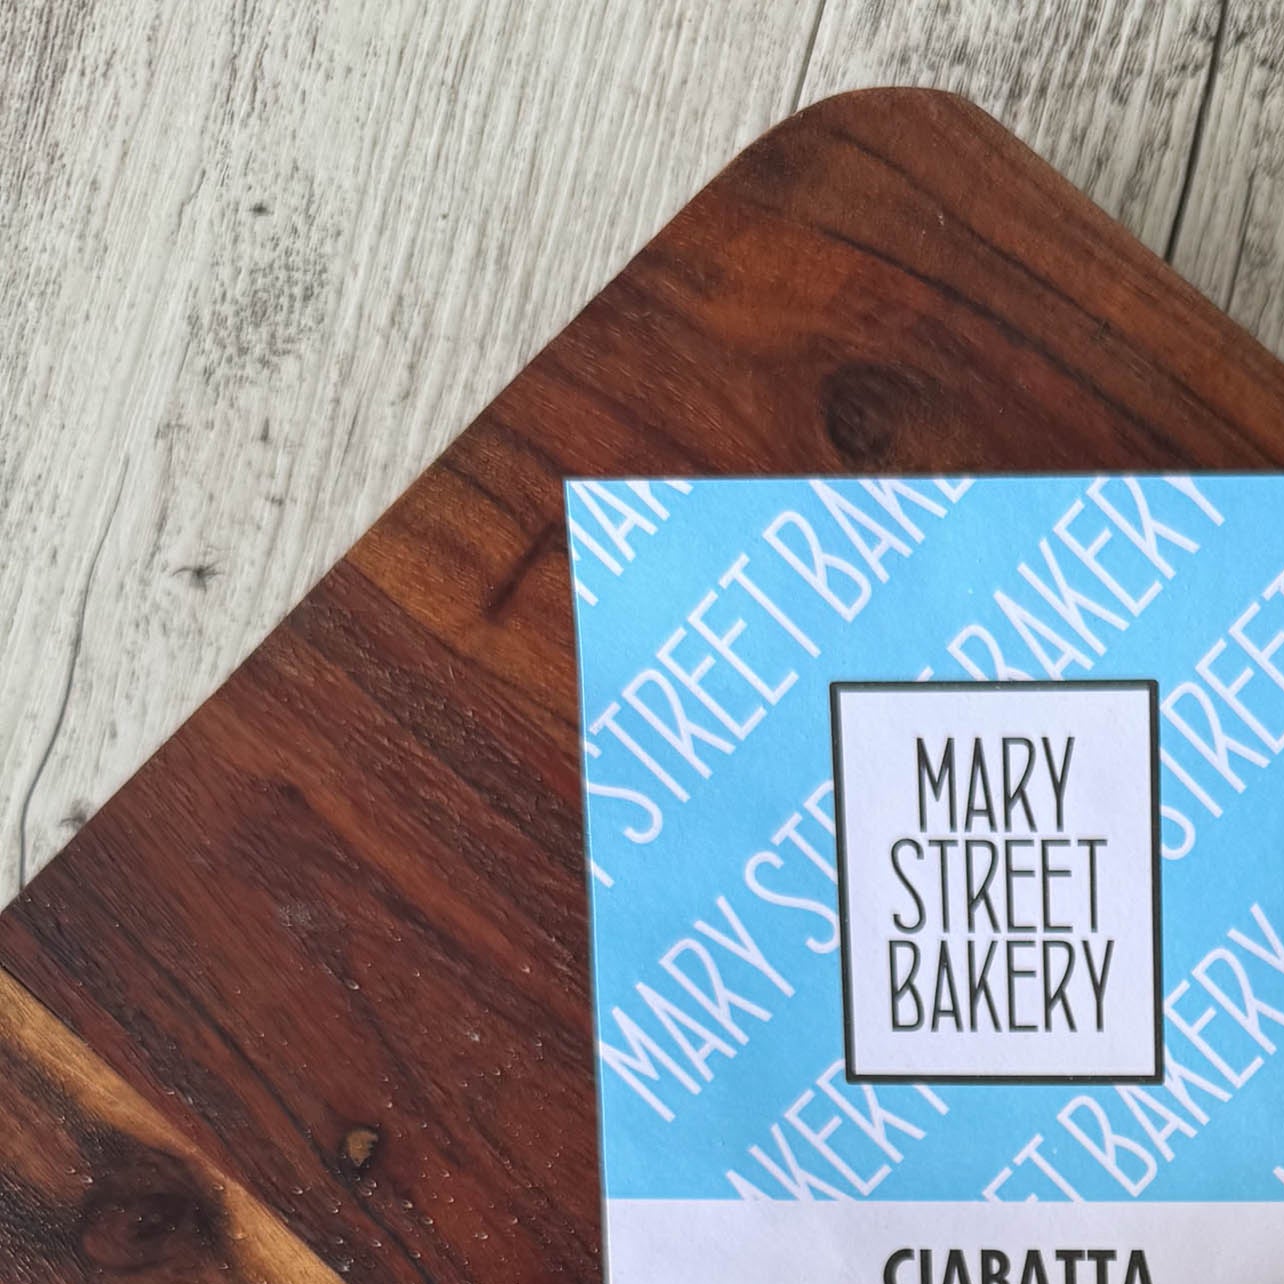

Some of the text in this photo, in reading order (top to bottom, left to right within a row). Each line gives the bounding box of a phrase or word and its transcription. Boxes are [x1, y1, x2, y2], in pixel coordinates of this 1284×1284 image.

[585, 478, 976, 844] STREET BAK
[915, 735, 1076, 833] MARY
[890, 838, 1109, 934] STREET
[598, 895, 795, 1123] MARY
[888, 940, 1116, 1033] BAKERY
